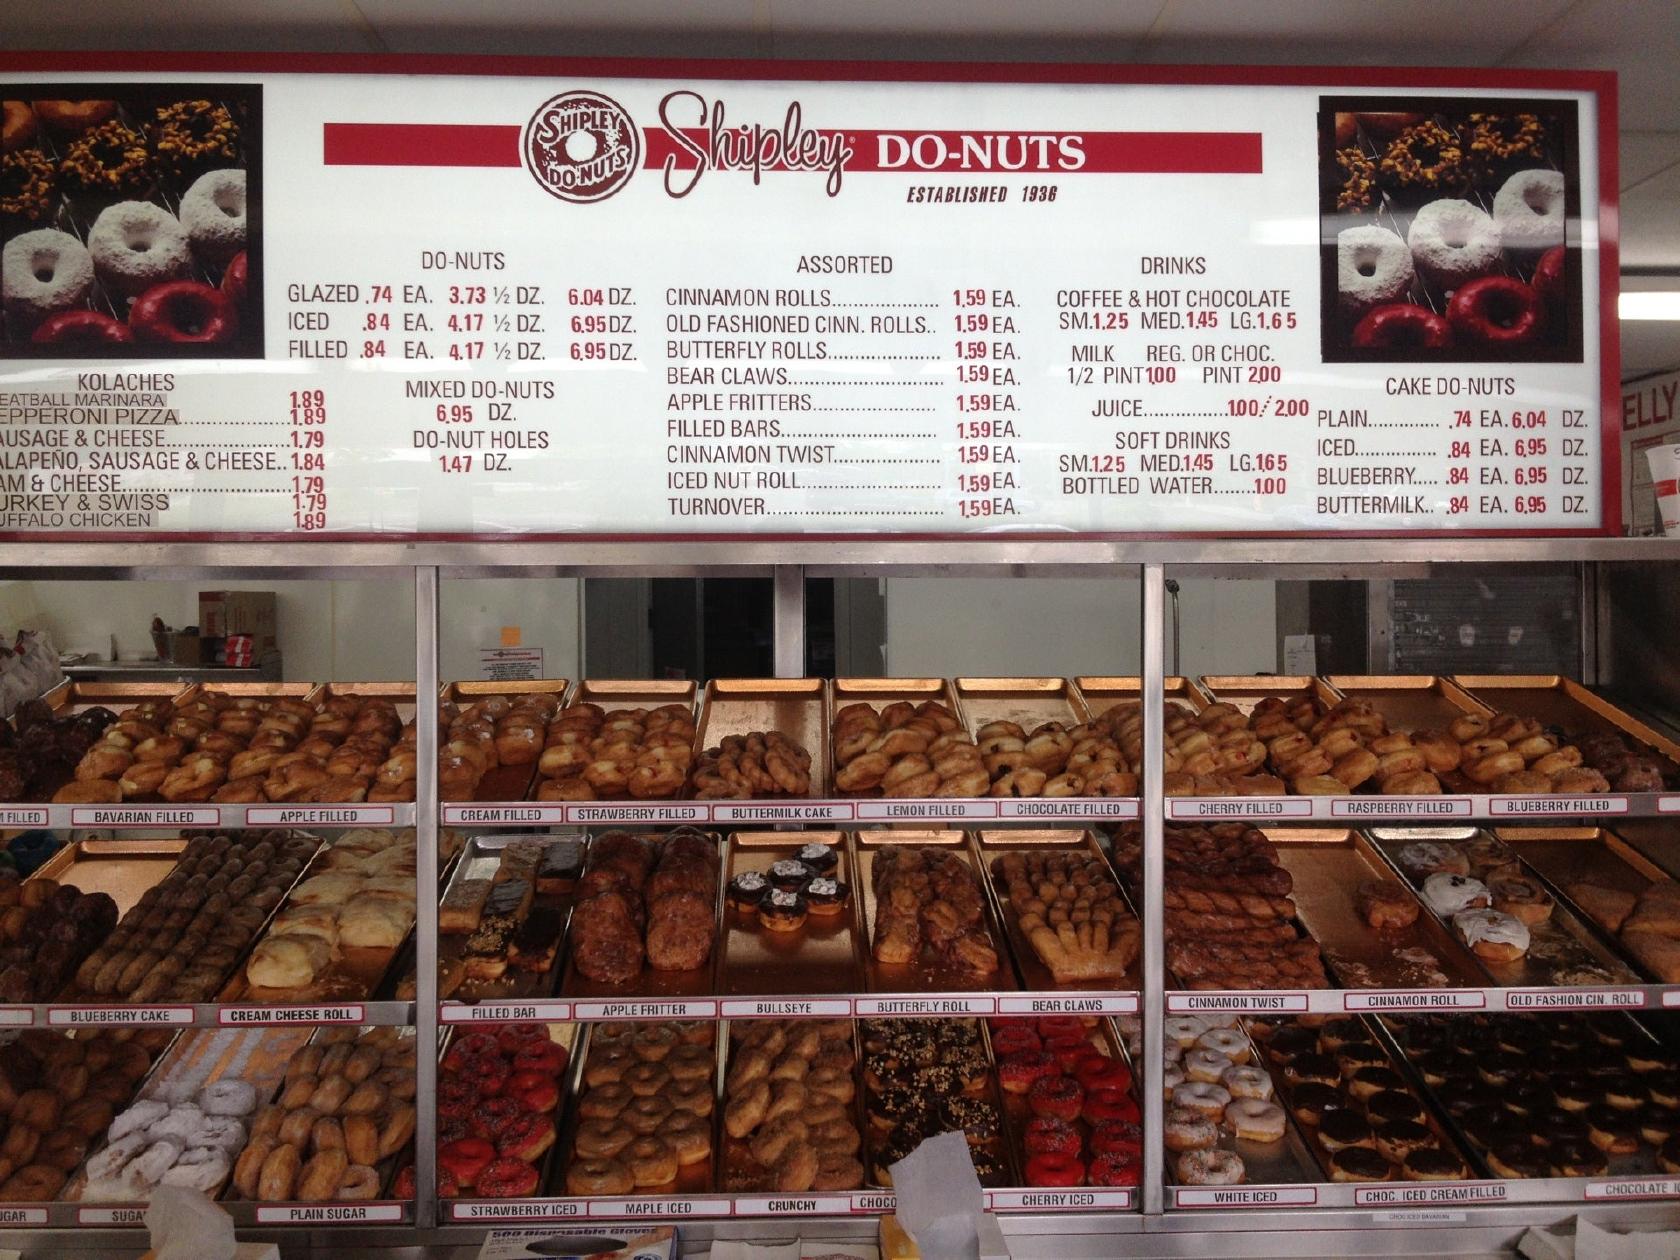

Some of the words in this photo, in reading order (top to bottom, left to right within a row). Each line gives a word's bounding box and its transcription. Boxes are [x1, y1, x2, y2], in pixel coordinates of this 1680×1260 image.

[540, 110, 620, 143] SHIPLEY
[660, 90, 851, 198] Shipley
[876, 134, 1086, 170] DO-NUTS
[906, 186, 1007, 203] ESTABLISHED
[1021, 186, 1058, 202] 1936
[421, 252, 505, 270] DO-NUTS
[797, 256, 893, 274] ASSORTED
[1141, 257, 1206, 274] DRINKS
[288, 284, 359, 303] GLAZED
[366, 286, 392, 304] .74
[403, 287, 433, 303] EA.
[449, 286, 486, 304] 3.73
[516, 287, 545, 305] DZ.
[568, 288, 603, 306] 6.04
[609, 288, 636, 306] DZ.
[666, 289, 769, 306] CINNAMON
[954, 290, 985, 307] 1.59
[993, 291, 1021, 307] EA.
[1057, 290, 1122, 307] COFFEE
[1129, 290, 1141, 307] &
[1146, 290, 1180, 307] HOT
[1187, 290, 1290, 307] CHOCOLATE
[288, 313, 329, 330] ICED
[362, 313, 389, 331] .84
[404, 314, 433, 331] EA.
[448, 314, 483, 331] 4.17
[517, 315, 545, 333] DZ.
[570, 316, 606, 333] 6.95
[609, 316, 637, 333] DZ.
[666, 315, 700, 332] OLD
[707, 315, 809, 333] FASHIONED
[815, 316, 865, 333] CINN.
[289, 341, 347, 359] FILLED
[360, 340, 385, 359] .84
[404, 342, 434, 359] EA.
[449, 342, 483, 360] 4.17
[517, 342, 545, 360] DZ.
[570, 343, 605, 362] 6.95
[609, 343, 637, 361] DZ.
[667, 341, 765, 359] BUTTERFLY
[955, 342, 987, 359] 1.59
[993, 343, 1021, 359] EA.
[1072, 345, 1115, 362] MILK
[1147, 345, 1185, 362] REG.
[1192, 345, 1215, 361] OR
[1221, 345, 1275, 362] CHOC.
[78, 373, 175, 391] KOLACHES
[667, 368, 714, 384] BEAR
[406, 381, 465, 398] MIXED
[472, 381, 554, 399] DO-NUTS
[1386, 378, 1431, 395] CAKE
[1437, 378, 1515, 395] DO-NUTS
[75, 393, 164, 407] MARINARA
[667, 394, 723, 411] APPLE
[436, 405, 472, 423] 6.95
[489, 403, 516, 421] DZ.
[1481, 411, 1508, 427] EA.
[1512, 410, 1546, 428] 6.04
[1562, 410, 1588, 427] DZ.
[667, 420, 724, 437] FILLED
[291, 431, 324, 448] 1.79
[413, 431, 484, 448] DO-NUT
[491, 431, 549, 449] HOLES
[1115, 432, 1160, 449] SOFT
[1166, 432, 1230, 449] DRINKS
[667, 446, 770, 463] CINNAMON
[1515, 438, 1547, 458] 6.95
[89, 452, 179, 470] SAUSAGE
[186, 452, 200, 470] &
[291, 453, 325, 470] 1.84
[439, 456, 472, 473] 1.47
[484, 453, 511, 471] DZ.
[292, 477, 324, 493] 1.79
[668, 472, 707, 489] ICED
[714, 472, 750, 489] NUT
[1063, 477, 1139, 494] BOTTLED
[98, 494, 169, 510] SWISS
[959, 500, 990, 519] 1.59
[1562, 497, 1588, 513] DZ.
[69, 513, 151, 526] CHICKEN
[732, 807, 802, 819] BUTTERMILK
[805, 807, 832, 818] CAKE
[886, 804, 925, 816] LEMON
[928, 804, 965, 816] FILLED
[1017, 803, 1081, 815] CHOCOLATE
[1084, 803, 1120, 815] FILLED
[1199, 803, 1243, 814] CHERRY
[1246, 802, 1283, 814] FILLED
[1348, 802, 1414, 813] RASPBERRY
[1417, 802, 1453, 813] FILLED
[1507, 800, 1570, 811] BLUEBERRY
[1573, 800, 1609, 811] FILLED
[8, 813, 40, 822] FILLED
[94, 811, 152, 823] BAVARIAN
[156, 811, 194, 823] FILLED
[280, 811, 316, 822] APPLE
[319, 810, 357, 822] FILLED
[461, 809, 500, 821] CREAM
[504, 809, 541, 820] FILLED
[578, 808, 655, 820] STRAWBERRY
[658, 808, 696, 819] FILLED
[877, 1001, 939, 1013] BUTTERFLY
[942, 1000, 970, 1012] ROLL
[1032, 1000, 1061, 1012] BEAR
[1064, 1000, 1103, 1011] CLAWS
[1188, 997, 1247, 1009] CINNAMON
[1250, 996, 1285, 1008] TWIST
[1368, 995, 1429, 1006] CINNAMON
[1431, 995, 1459, 1006] ROLL
[1511, 995, 1533, 1006] OLD
[1536, 994, 1583, 1005] FASHION
[1612, 993, 1639, 1004] ROLL
[71, 1010, 137, 1022] BLUEBERRY
[141, 1010, 169, 1021] CAKE
[231, 1010, 272, 1021] CREAM
[275, 1009, 321, 1021] CHEESE
[324, 1009, 352, 1020] ROLL
[472, 1006, 510, 1018] FILLED
[513, 1006, 536, 1018] BAR
[603, 1003, 637, 1016] APPLE
[641, 1003, 686, 1015] FRITTER
[757, 1002, 812, 1014] BULLSEYE
[1403, 1190, 1426, 1200] ICED
[1431, 1189, 1468, 1200] CREAM
[1470, 1187, 1505, 1197] FILLED
[1606, 1183, 1667, 1194] CHOCOLATE
[860, 1197, 896, 1207] CHOCO
[1022, 1194, 1066, 1206] CHERRY
[1069, 1193, 1094, 1205] ICED
[1214, 1191, 1252, 1203] WHITE
[1253, 1191, 1278, 1202] ICED
[290, 1208, 325, 1220] PLAIN
[327, 1208, 366, 1219] SUGAR
[471, 1204, 549, 1217] STRAWBERRY
[552, 1204, 577, 1216] ICED
[625, 1203, 664, 1214] MAPLE
[667, 1202, 691, 1214] ICED
[768, 1200, 817, 1212] CRUNCHY
[0, 1211, 26, 1222] UGAR
[112, 1211, 147, 1222] SUGA
